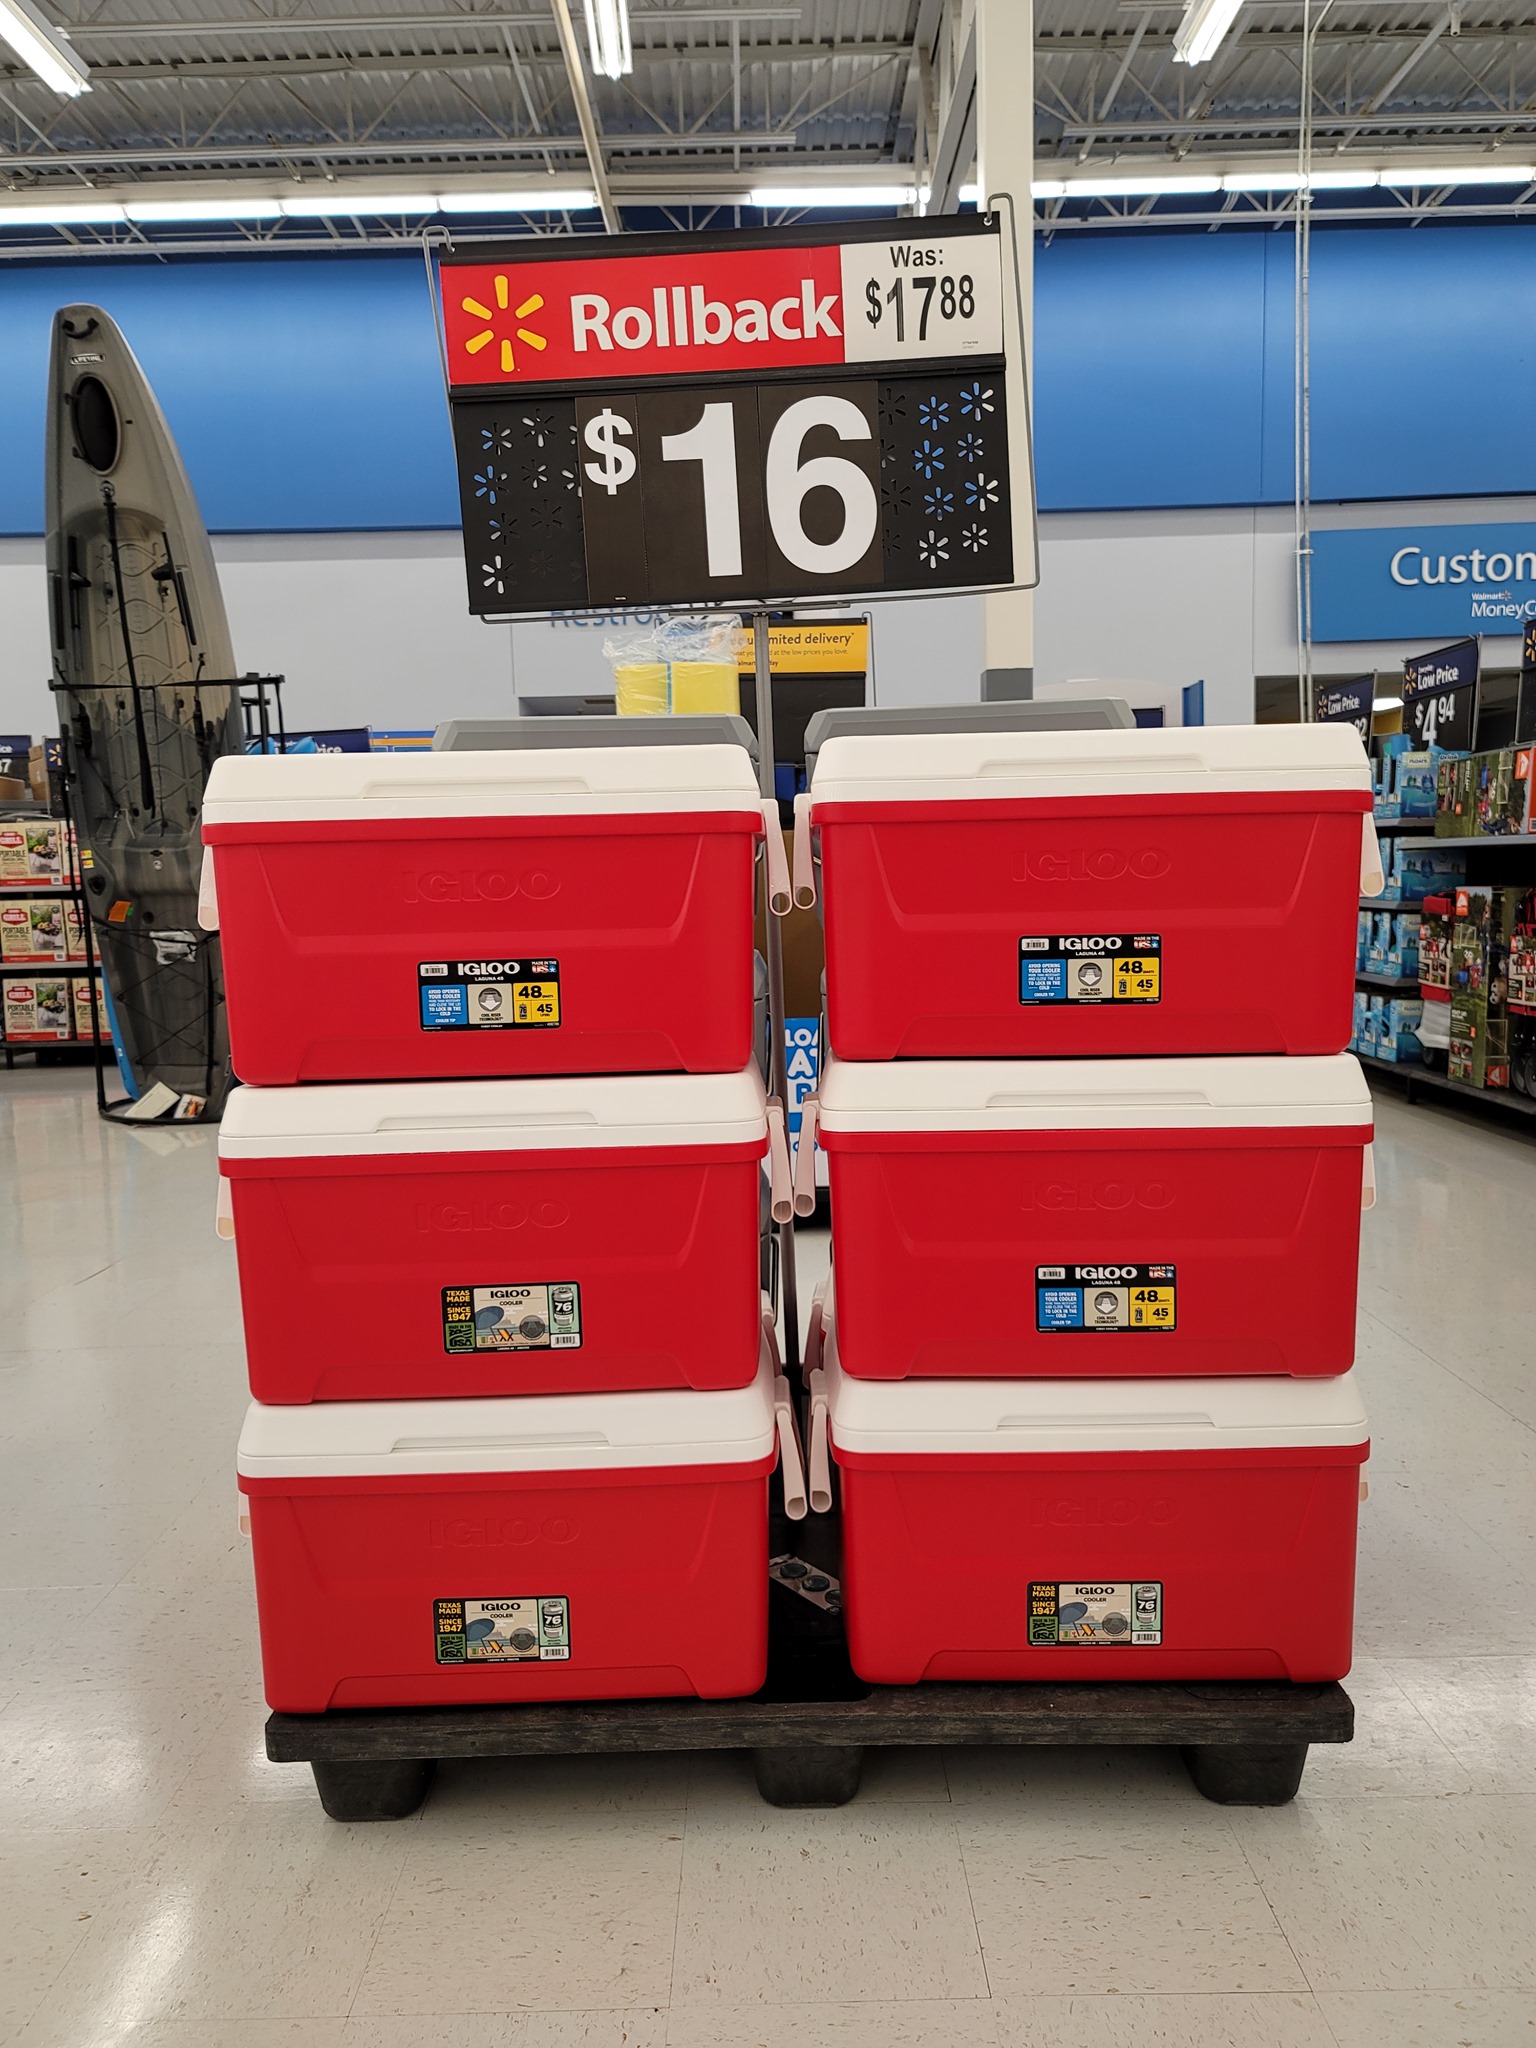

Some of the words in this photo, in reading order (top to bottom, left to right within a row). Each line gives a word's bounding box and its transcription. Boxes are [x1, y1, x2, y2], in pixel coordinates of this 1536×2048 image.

[890, 246, 943, 268] Was:
[570, 279, 843, 352] Rollback
[1471, 592, 1500, 600] Walmart
[1471, 600, 1536, 619] MoneyC
[747, 634, 801, 645] umited
[803, 649, 821, 657] prices
[1417, 674, 1435, 690] Low
[1436, 664, 1459, 685] Price
[1328, 701, 1341, 715] Low
[1341, 694, 1360, 711] Price
[1012, 848, 1171, 882] IGLOO
[403, 869, 562, 903] IGLOO
[1058, 937, 1122, 950] IGLOO
[457, 962, 521, 976] IGLOO
[1119, 961, 1143, 974] 48
[1137, 979, 1153, 988] 45
[518, 985, 542, 998] 48
[537, 1003, 553, 1013] 45
[1019, 1180, 1176, 1211] IGLOO
[416, 1200, 570, 1233] IGLOO
[1075, 1266, 1138, 1279] IGLOO
[490, 1289, 531, 1299] IGLOO
[1135, 1290, 1158, 1303] 48
[447, 1306, 471, 1314] SINCE
[554, 1302, 572, 1312] 76
[447, 1313, 471, 1321] 1947
[1152, 1308, 1168, 1317] 45
[449, 1338, 473, 1347] USA
[430, 1516, 581, 1548] IGLOO
[1075, 1586, 1115, 1595] IGLOO
[481, 1602, 521, 1611] IGLOO
[1137, 1600, 1155, 1610] 76
[1032, 1607, 1055, 1615] 1947
[544, 1615, 562, 1625] 76
[439, 1624, 462, 1632] 1947
[1033, 1632, 1056, 1640] USA
[440, 1650, 464, 1658] USA
